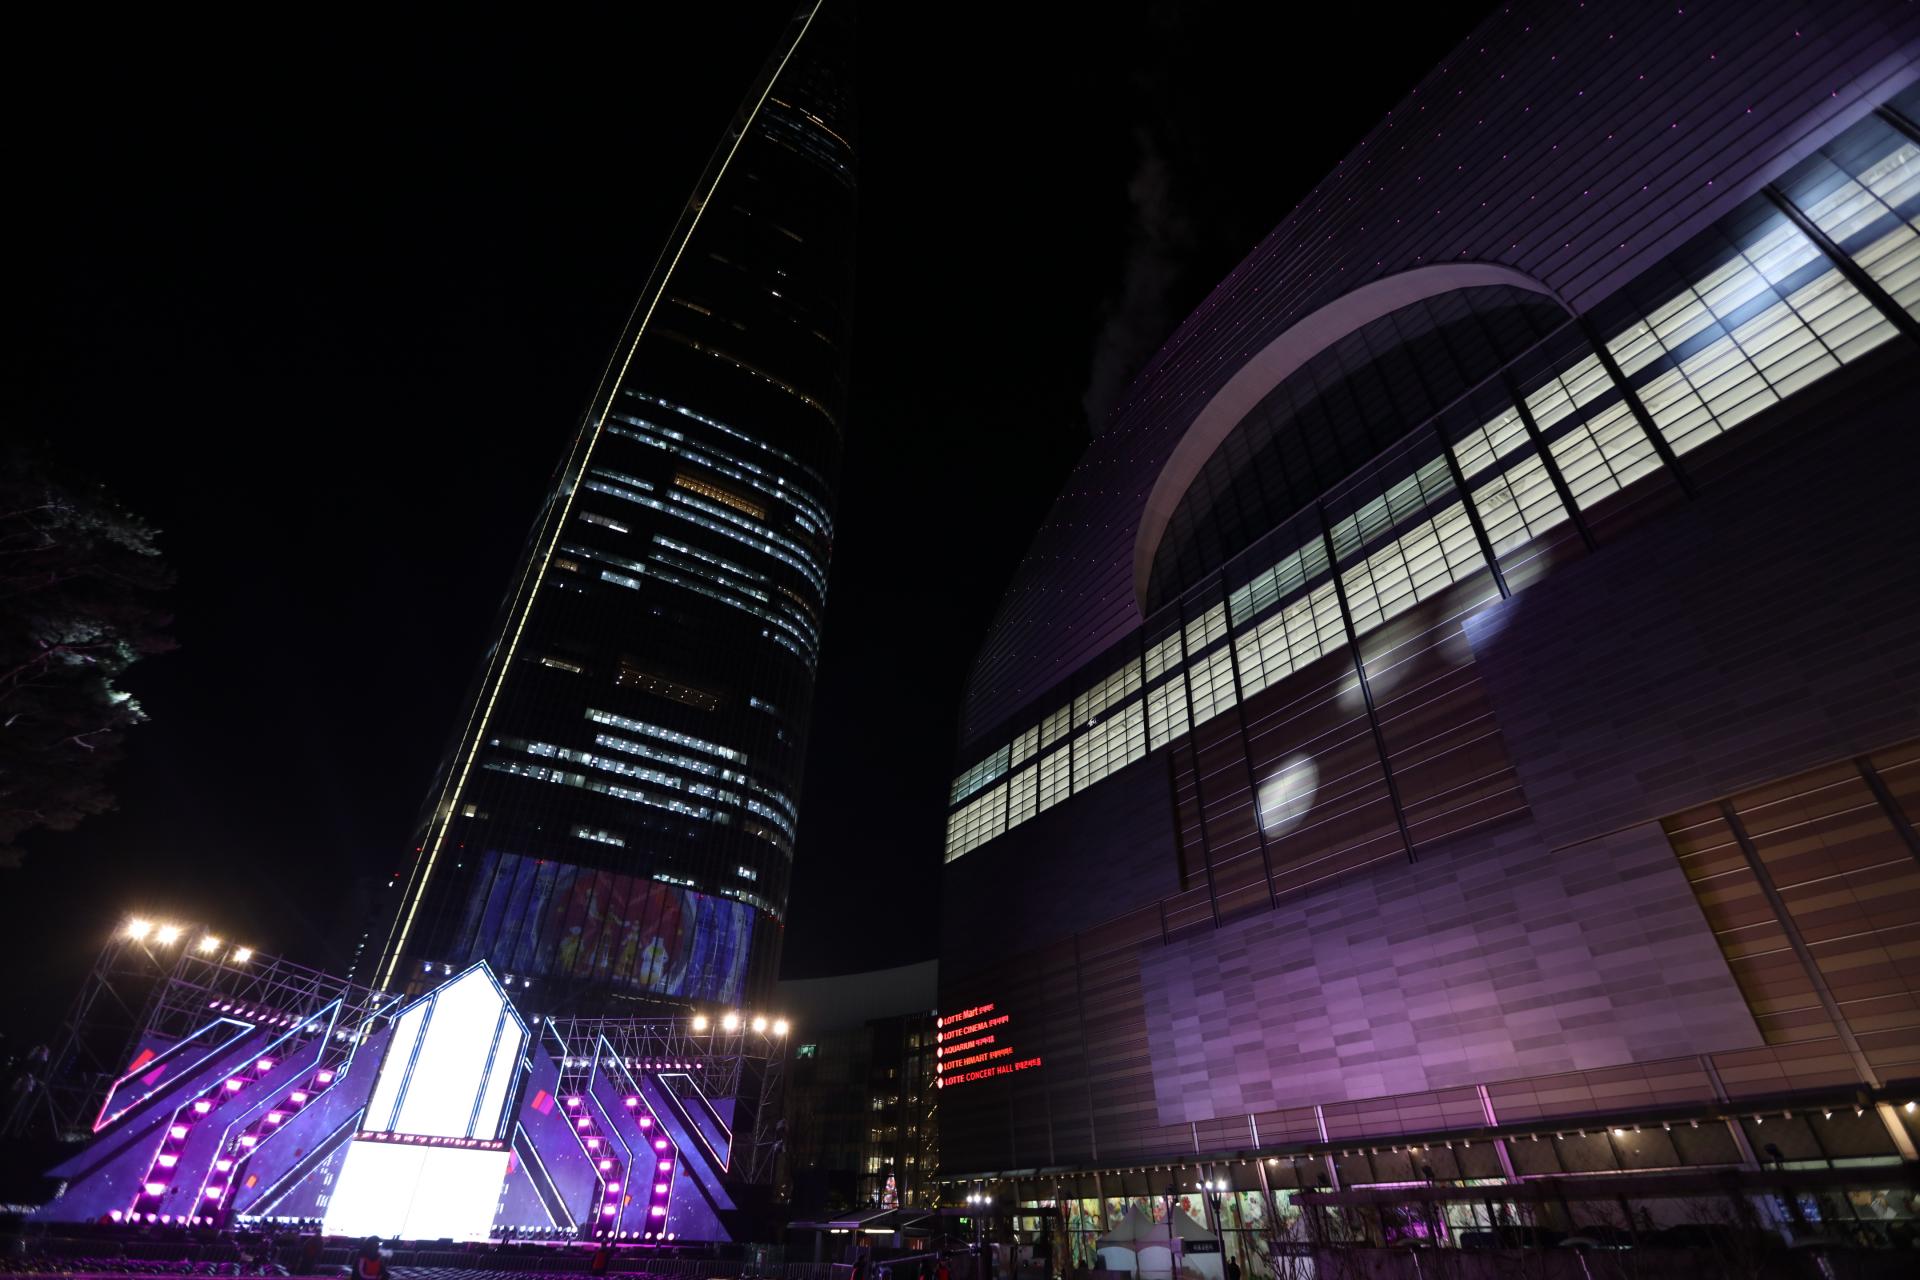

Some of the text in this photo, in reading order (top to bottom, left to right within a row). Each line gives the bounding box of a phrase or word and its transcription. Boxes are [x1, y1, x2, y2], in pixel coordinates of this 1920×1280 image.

[944, 1013, 963, 1025] LOTTE
[963, 1007, 978, 1019] Mart
[944, 1028, 963, 1040] LOTTE
[963, 1021, 988, 1034] CINEMA
[944, 1040, 975, 1054] AQUARIUM
[944, 1059, 963, 1071] LOTTE
[963, 1052, 988, 1066] HIMART
[945, 1074, 965, 1086] LOTTE
[966, 1067, 995, 1081] CONCERT
[997, 1064, 1013, 1075] HALL
